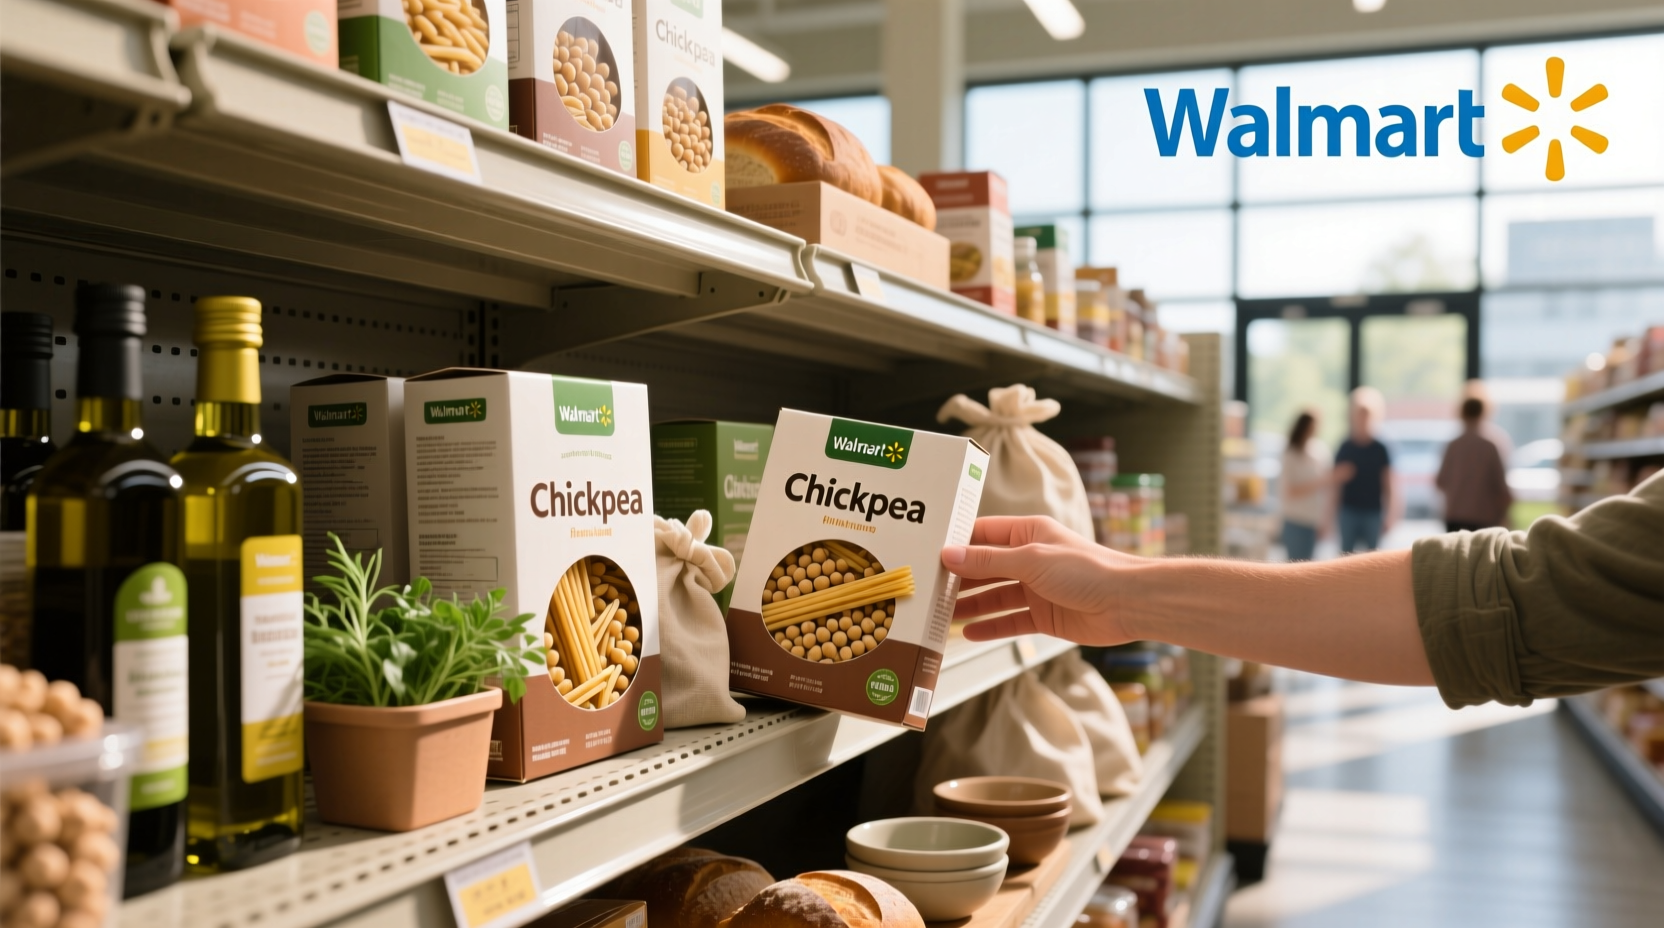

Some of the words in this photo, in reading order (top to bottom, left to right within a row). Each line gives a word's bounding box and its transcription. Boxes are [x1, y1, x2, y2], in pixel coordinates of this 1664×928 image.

[559, 405, 599, 423] Walmart
[833, 435, 886, 457] Walmart
[530, 480, 643, 524] Chickpea
[784, 472, 926, 524] Chickpea
